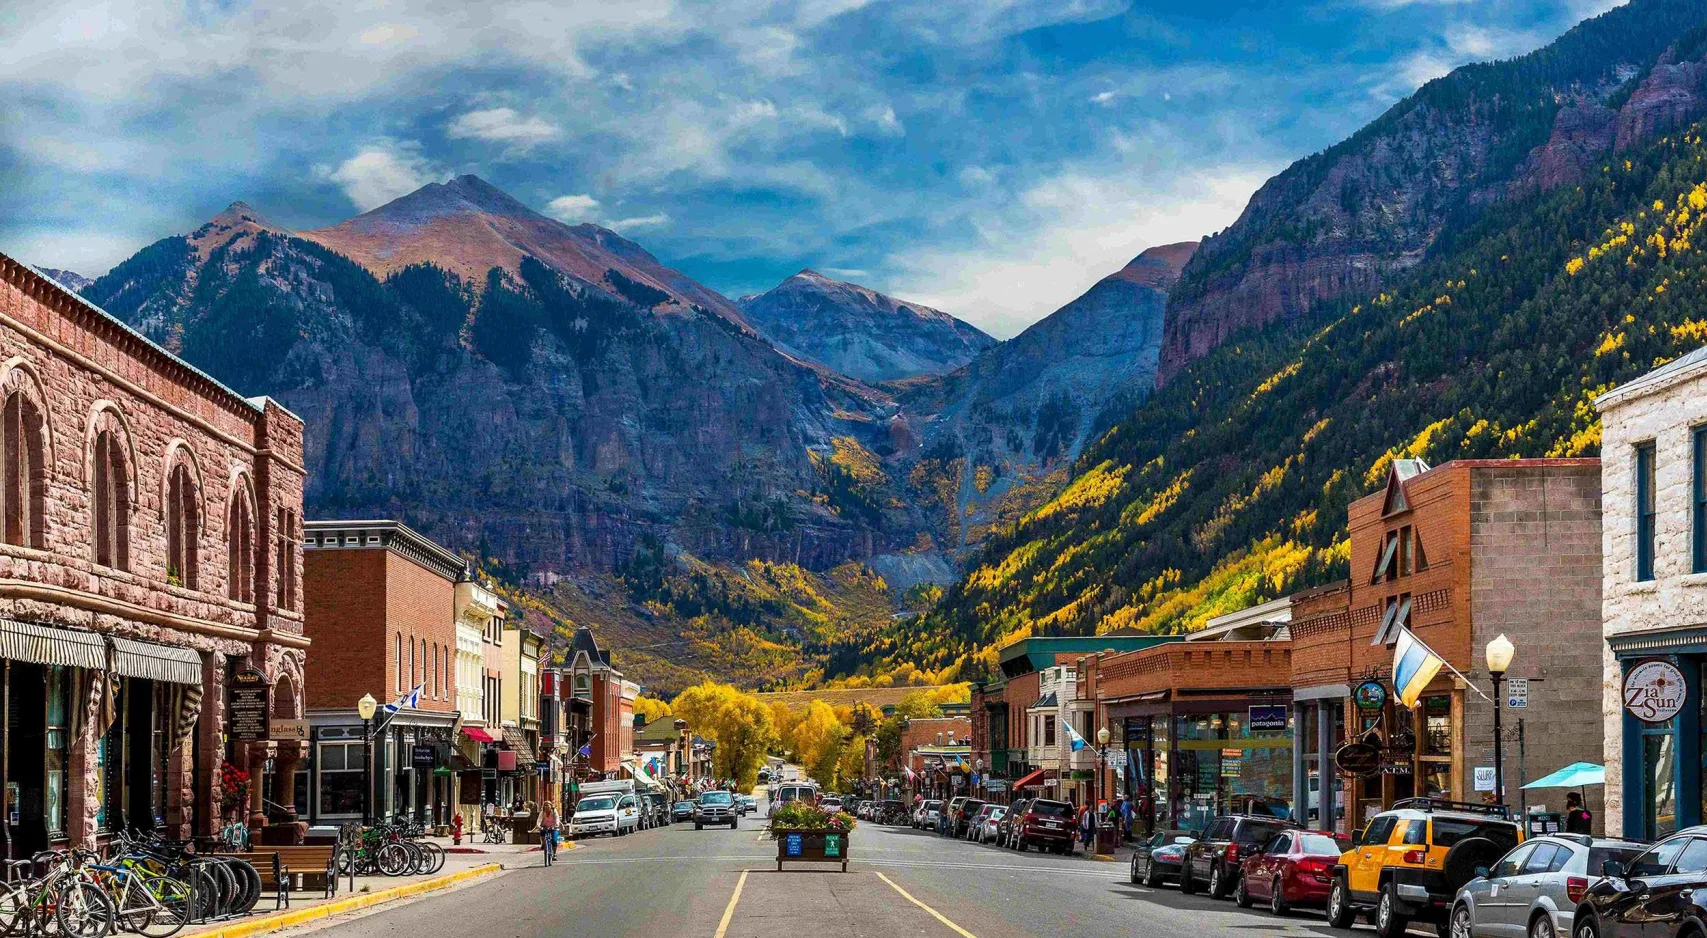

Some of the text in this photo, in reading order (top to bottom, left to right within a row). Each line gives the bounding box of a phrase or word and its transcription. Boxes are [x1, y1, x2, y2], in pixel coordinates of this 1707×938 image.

[1626, 684, 1659, 708] Zia
[1643, 698, 1676, 719] Sun
[1251, 719, 1284, 728] patagonia
[1476, 769, 1494, 781] SLURP
